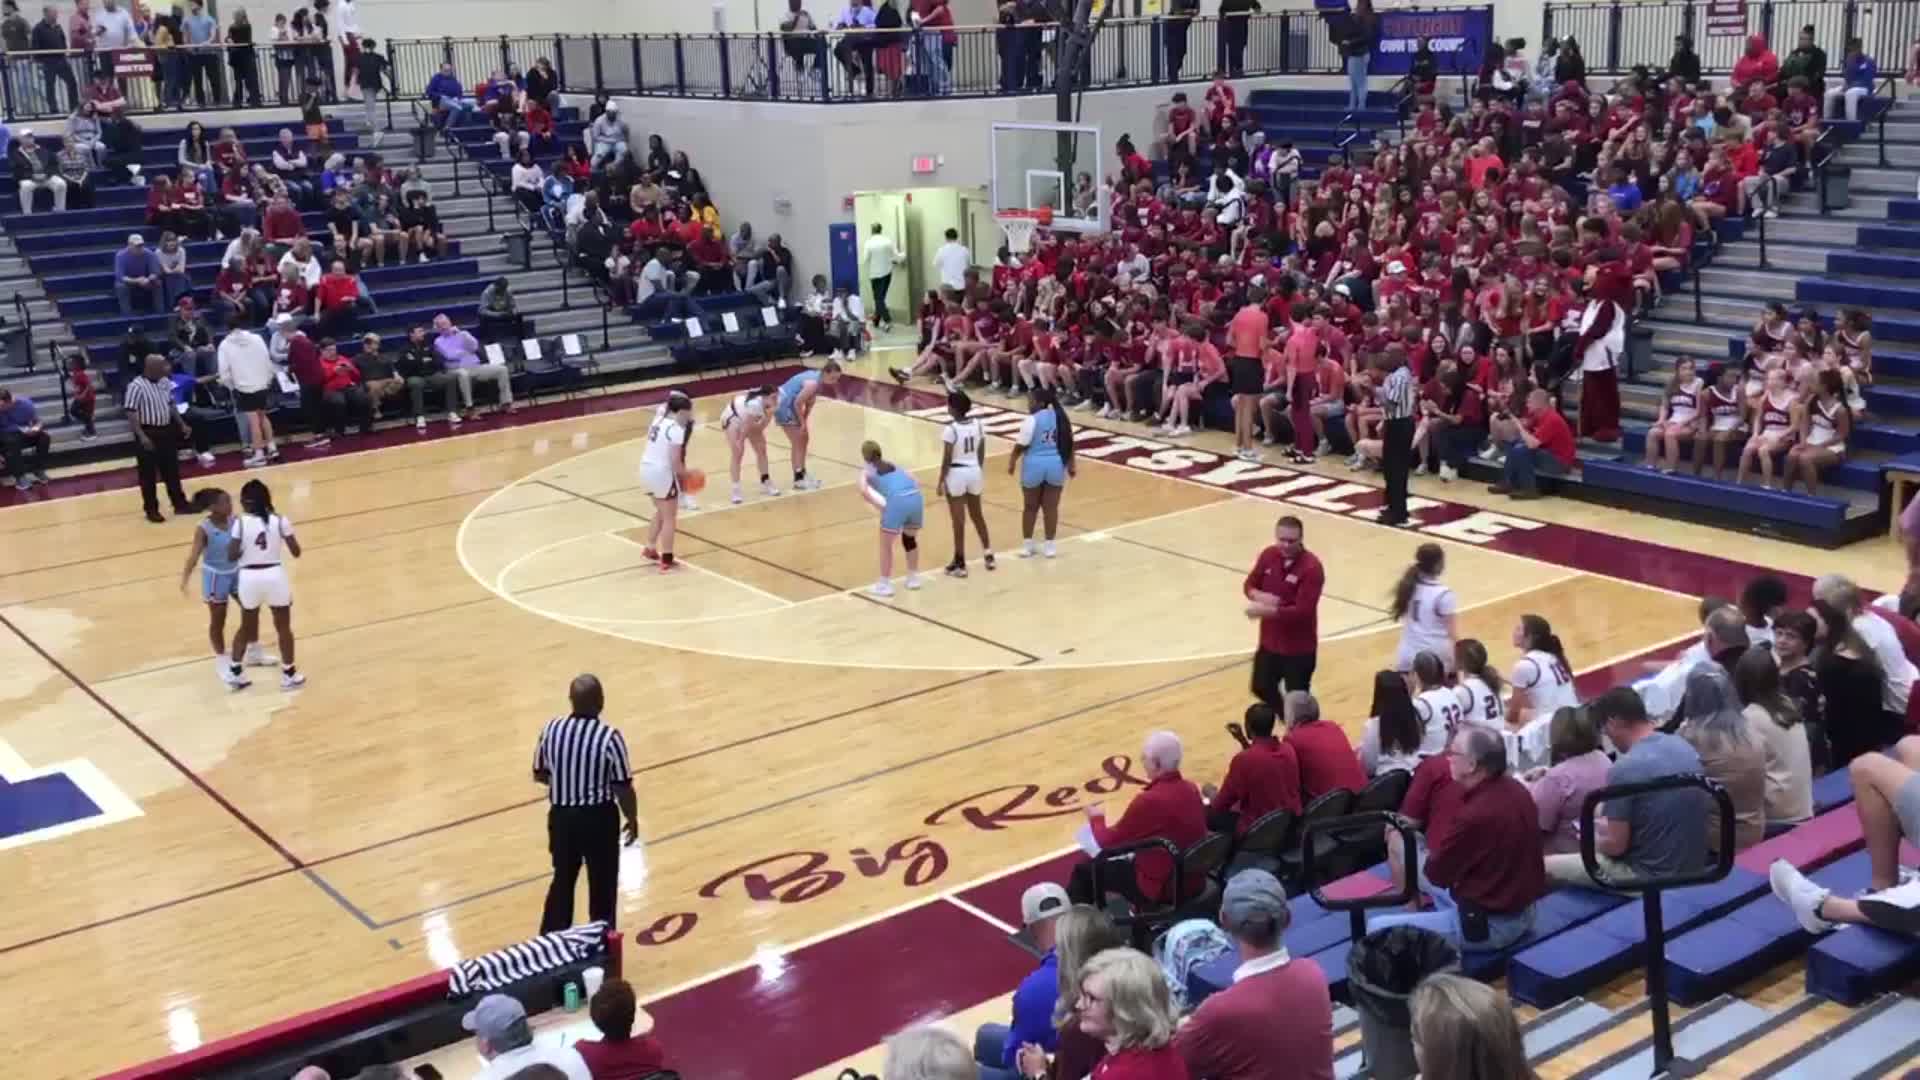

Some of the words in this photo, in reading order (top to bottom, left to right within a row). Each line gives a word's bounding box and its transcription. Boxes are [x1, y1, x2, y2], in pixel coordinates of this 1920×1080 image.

[963, 436, 974, 454] 11
[254, 531, 268, 550] 4
[636, 911, 699, 946] o
[699, 834, 949, 903] Big
[923, 753, 1152, 831] Red
